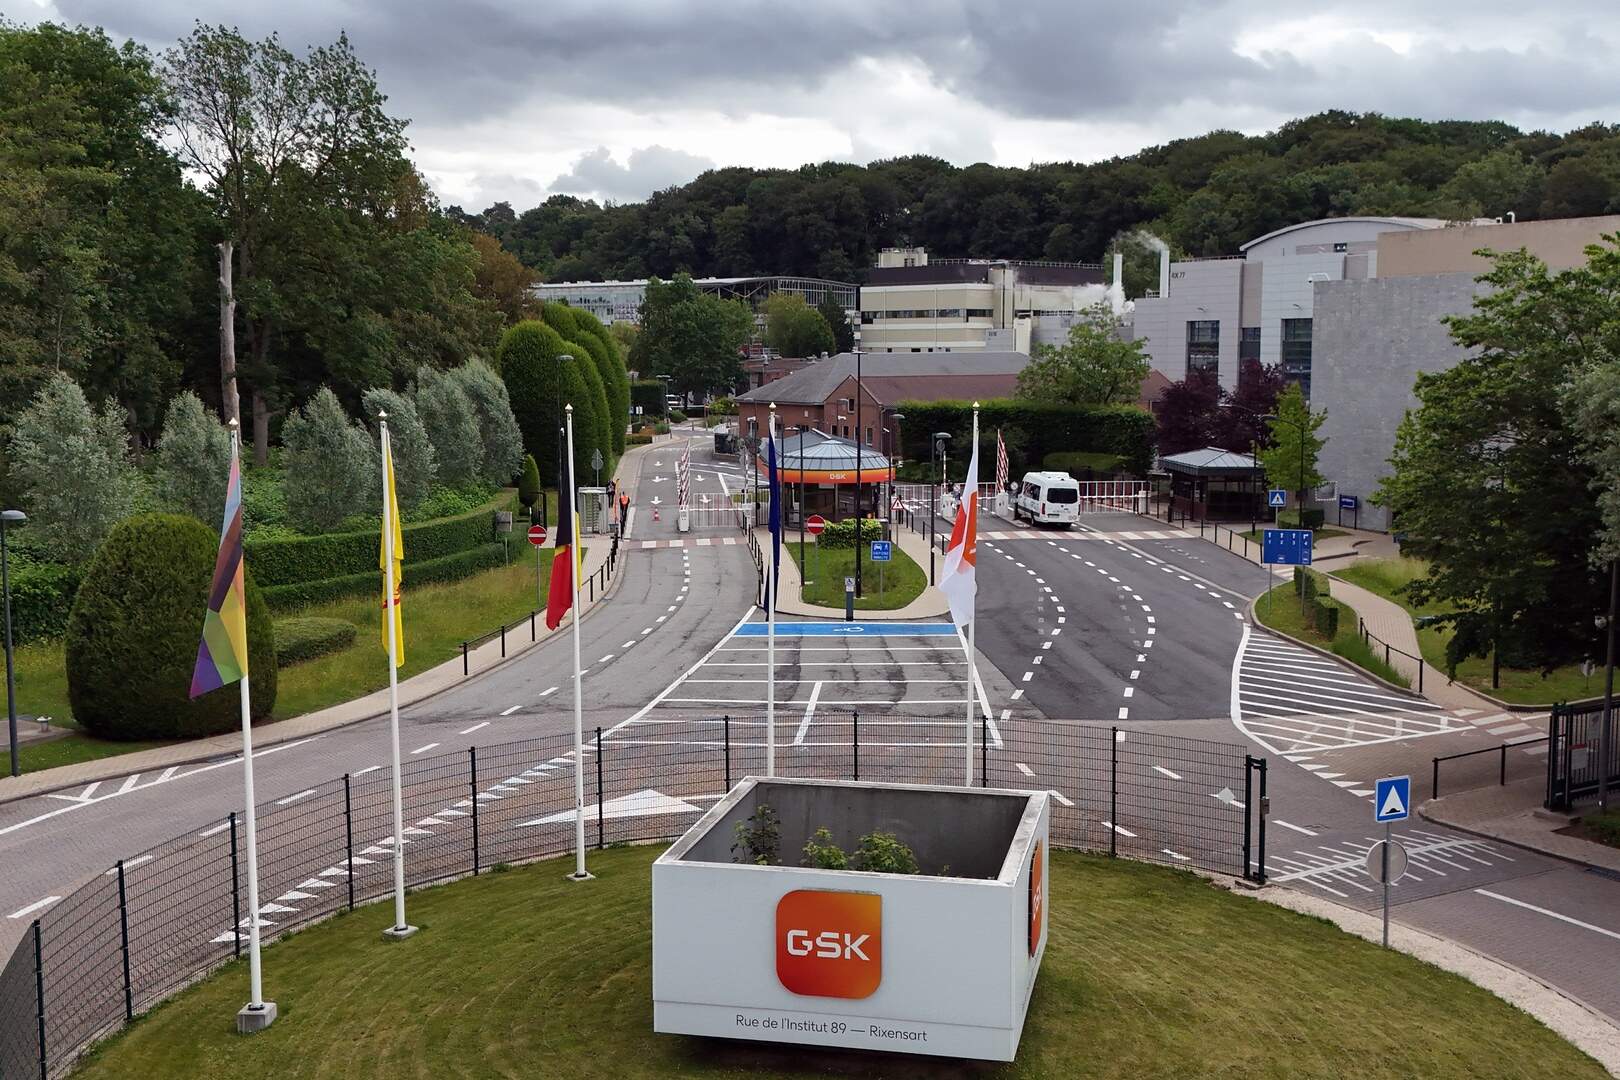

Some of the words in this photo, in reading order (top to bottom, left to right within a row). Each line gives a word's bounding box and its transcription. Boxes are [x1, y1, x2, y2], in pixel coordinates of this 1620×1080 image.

[787, 929, 871, 961] GSK
[736, 1014, 760, 1028] Rue
[762, 1017, 778, 1029] de
[781, 1018, 828, 1033] l'Institut
[830, 1021, 847, 1034] 89
[869, 1025, 928, 1042] Rixensart
